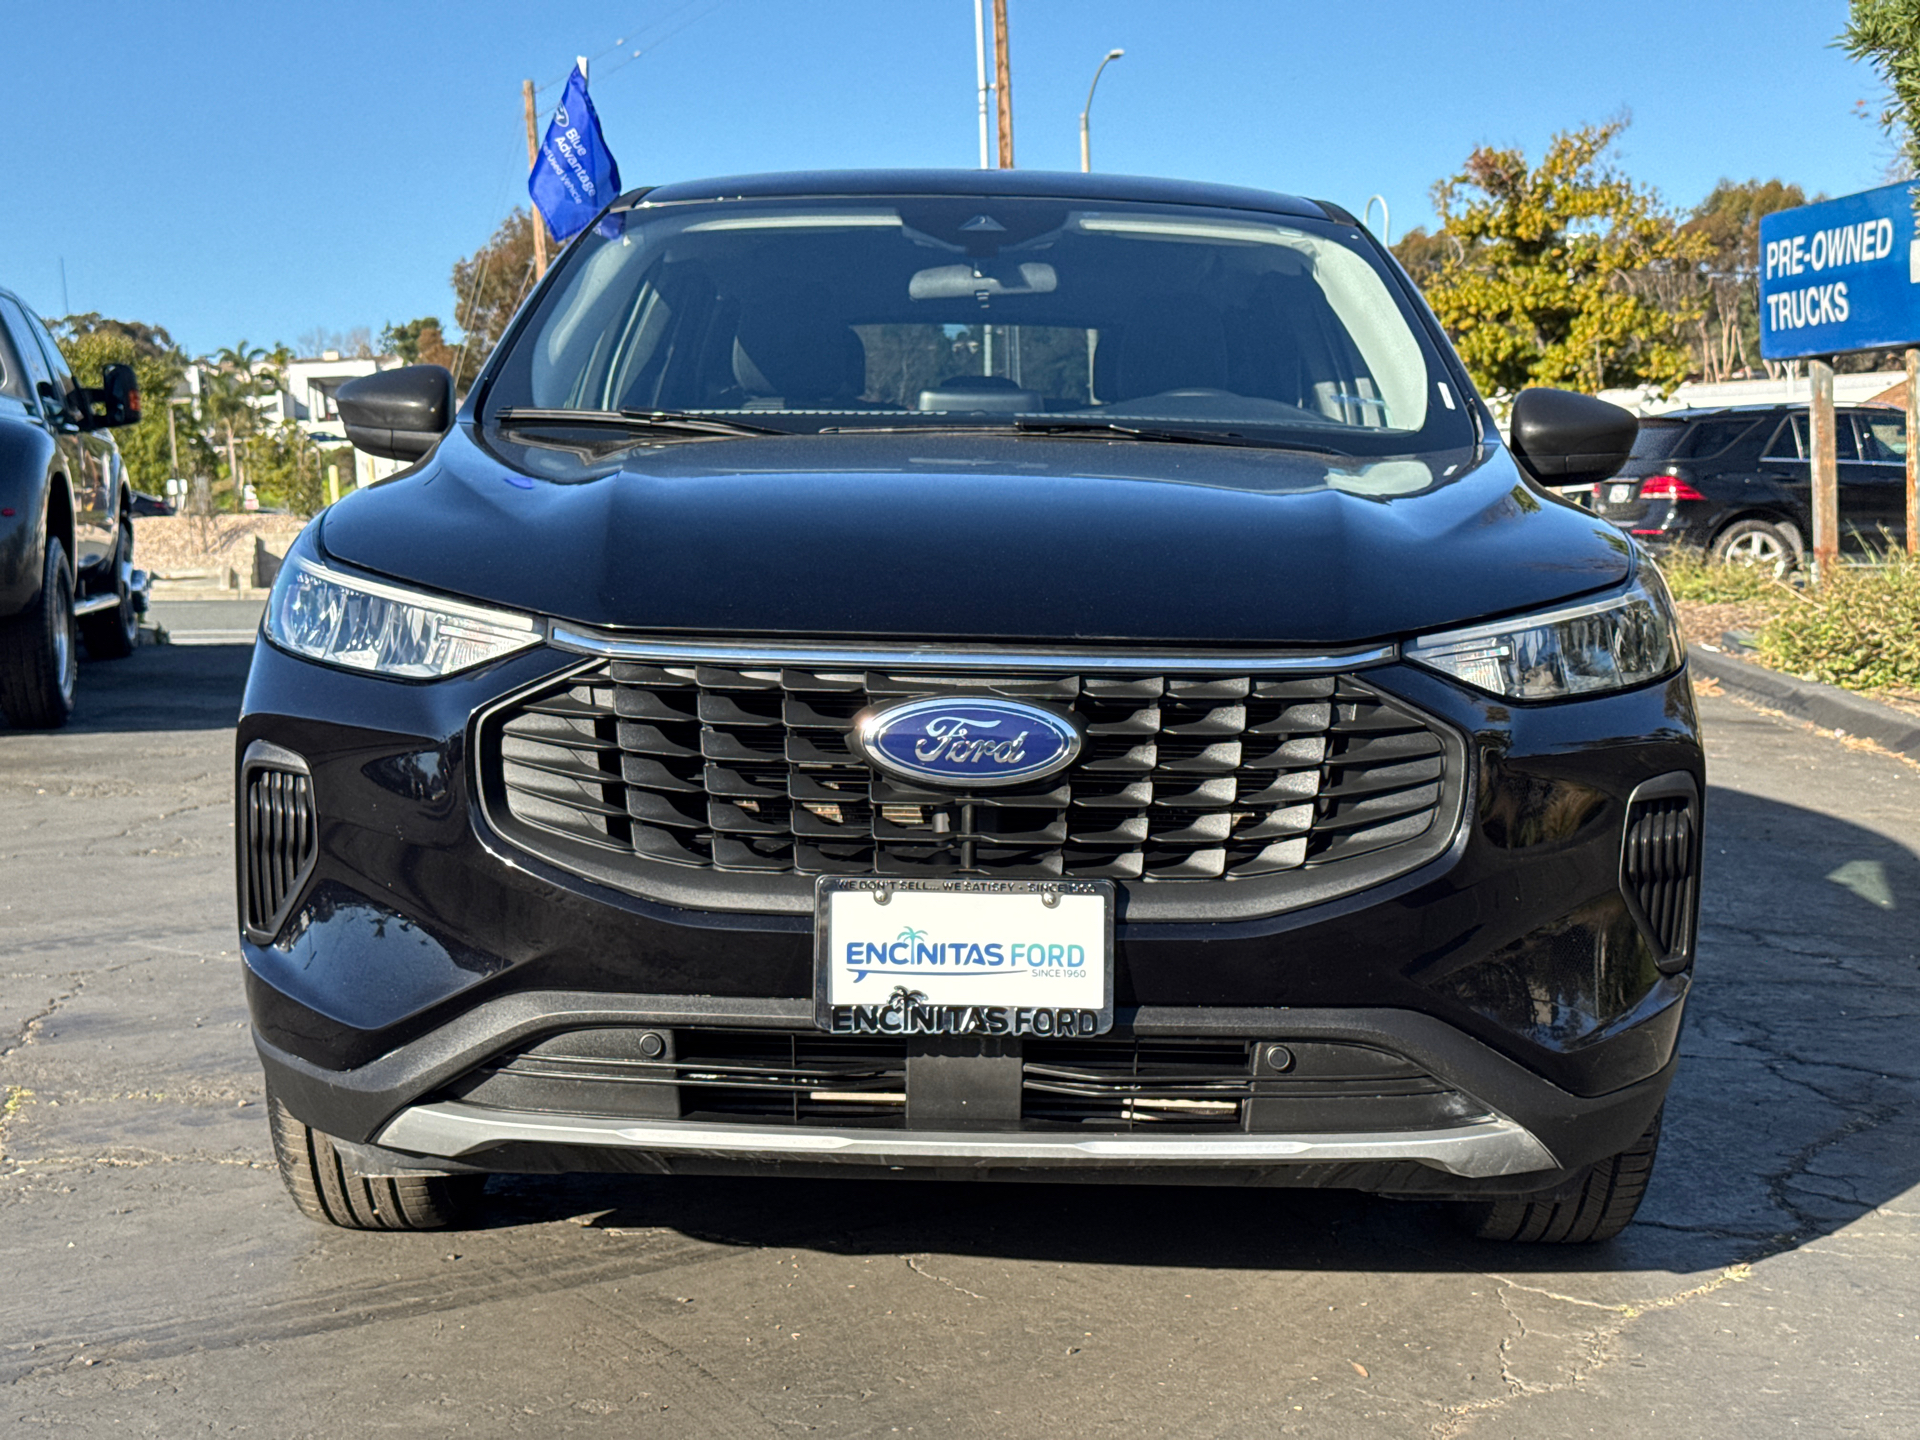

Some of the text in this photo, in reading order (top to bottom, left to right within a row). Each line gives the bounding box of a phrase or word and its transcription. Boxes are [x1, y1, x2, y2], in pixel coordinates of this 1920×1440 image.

[565, 128, 587, 156] Blue
[554, 136, 596, 197] Advantage
[560, 173, 582, 205] Vehicle
[1766, 217, 1893, 281] PRE-OWNED
[1766, 281, 1849, 332] TRUCKS
[914, 715, 1030, 764] Ford
[838, 879, 857, 890] WE
[859, 880, 897, 891] DON'T
[942, 881, 961, 892] WE
[963, 881, 1015, 892] SATISFY
[1026, 882, 1065, 893] SINCE
[846, 941, 1085, 968] ENCINITAS FORD
[1031, 968, 1087, 978] SINCE 1960
[830, 1004, 1099, 1036] ENCINITAS FORD
